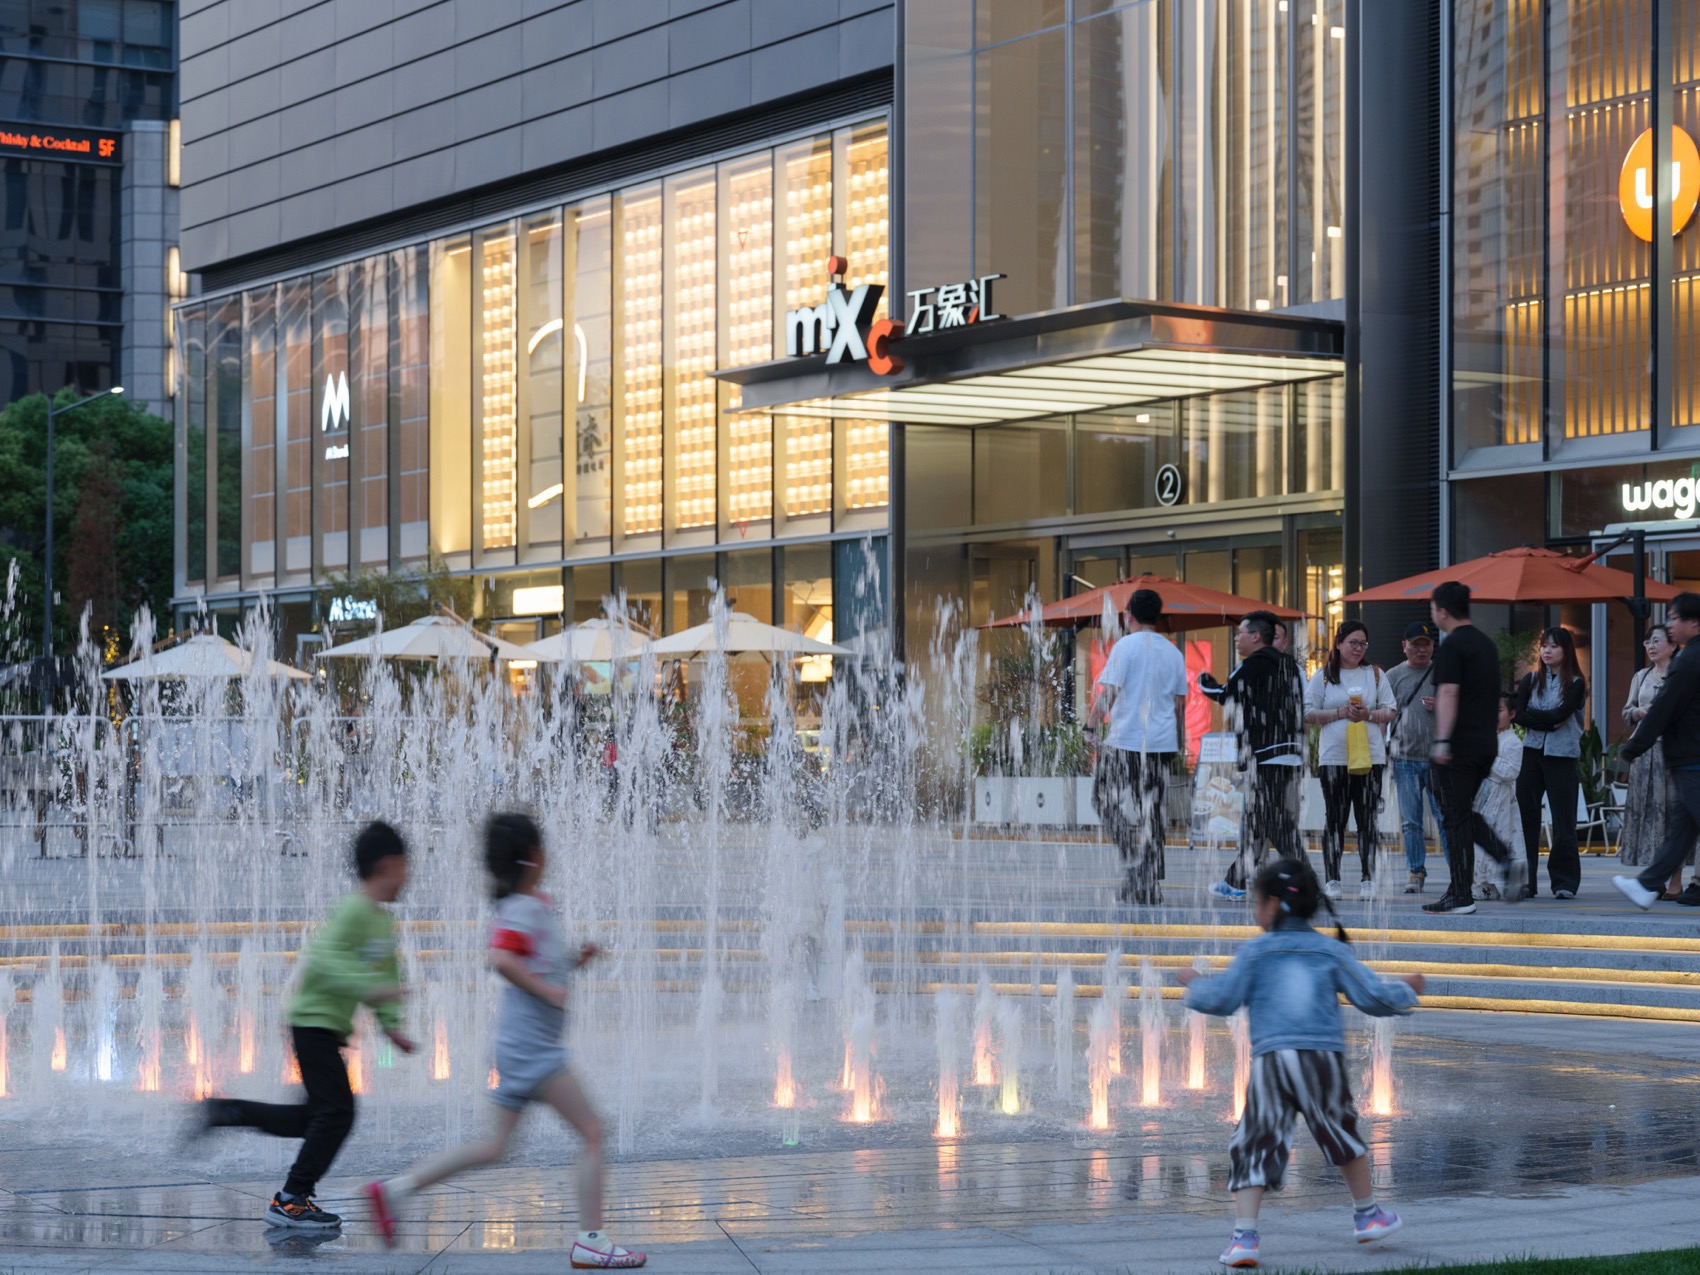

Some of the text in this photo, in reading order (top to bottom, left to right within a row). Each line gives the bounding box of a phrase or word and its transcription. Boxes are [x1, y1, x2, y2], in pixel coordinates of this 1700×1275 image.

[30, 135, 42, 148] &
[43, 136, 90, 152] Cocktail
[906, 274, 1007, 335] 万象汇
[1622, 477, 1700, 519] wag
